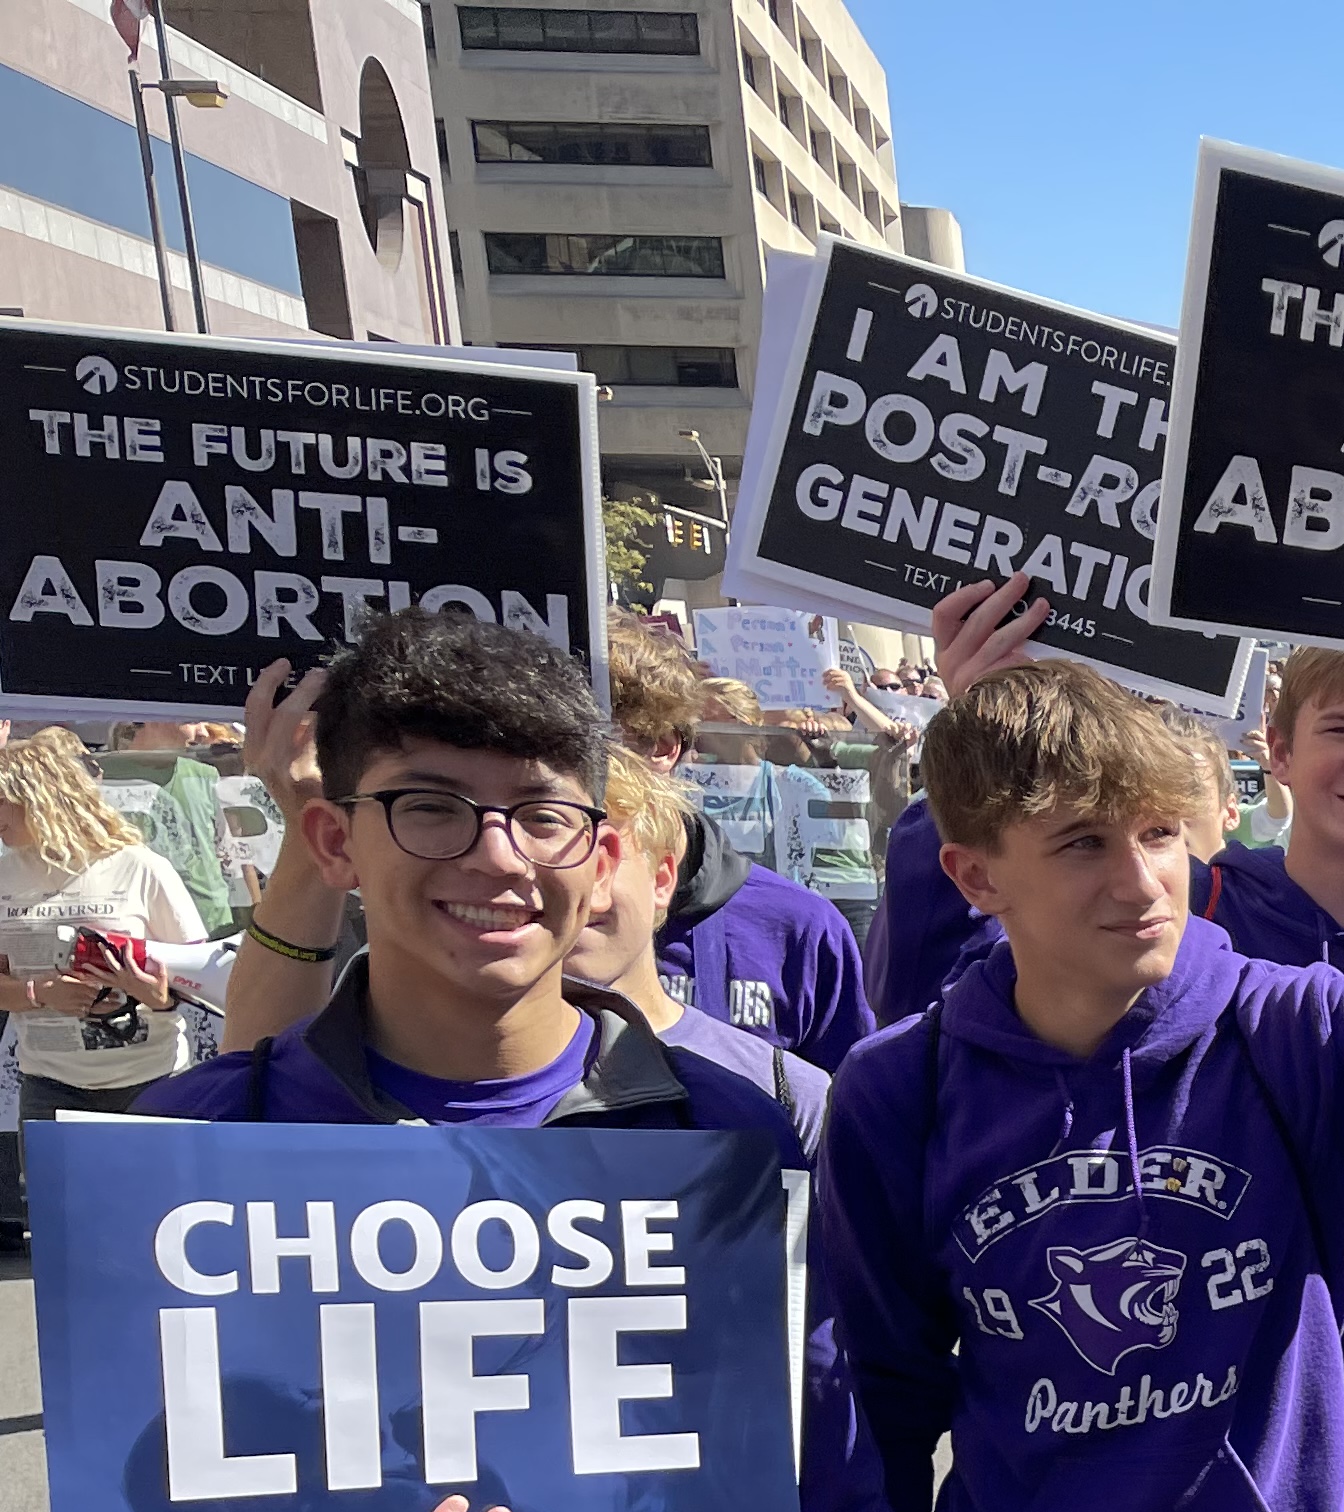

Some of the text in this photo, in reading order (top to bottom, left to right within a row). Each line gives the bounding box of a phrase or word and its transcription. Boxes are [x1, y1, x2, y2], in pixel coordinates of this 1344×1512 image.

[844, 308, 1170, 454] I AM TH
[940, 297, 1173, 388] STUDENTSFORLIFE.
[125, 365, 489, 421] STUDENTSFORLIFE.ORG
[29, 408, 533, 494] THE FUTURE IS
[801, 369, 1163, 543] POST-RO
[139, 480, 439, 564] ANTI-
[795, 462, 1156, 623] GENERATIO
[904, 563, 951, 593] TEXT
[1045, 608, 1097, 638] 3445
[180, 663, 235, 686] TEXT
[735, 655, 817, 678] Matter
[37, 903, 114, 917] REVERSED
[154, 1199, 687, 1297] CHOOSE
[963, 1238, 1274, 1340] 19 22
[159, 1294, 701, 1502] LIFE
[1024, 1365, 1240, 1434] Panthers
